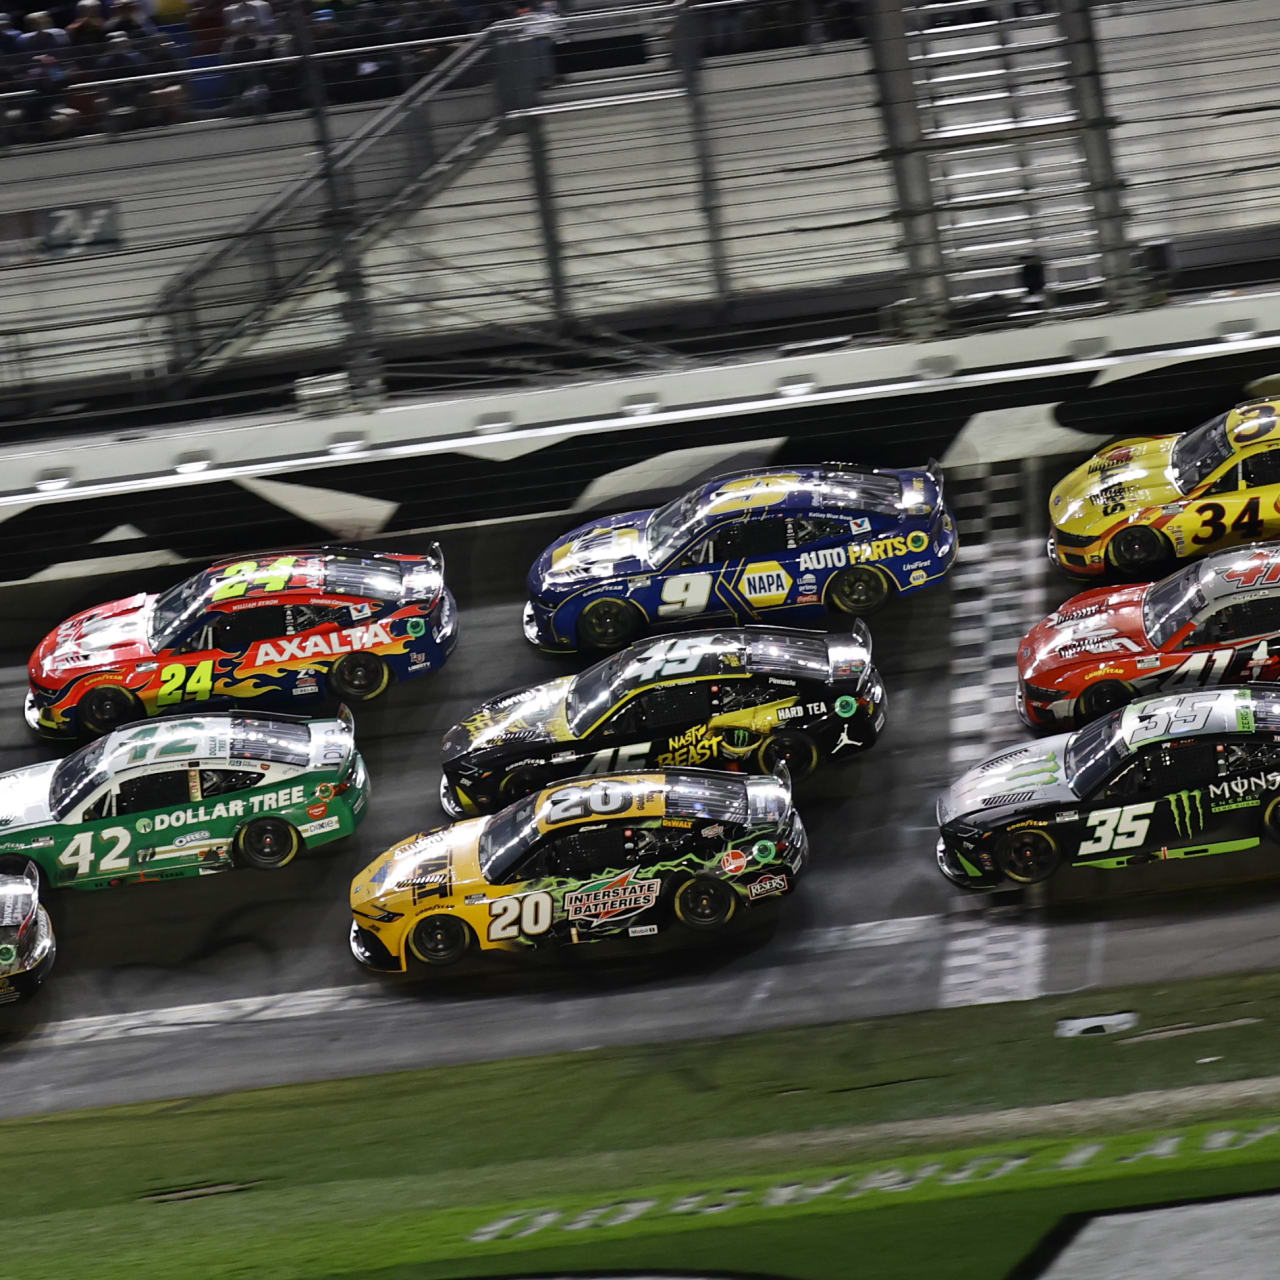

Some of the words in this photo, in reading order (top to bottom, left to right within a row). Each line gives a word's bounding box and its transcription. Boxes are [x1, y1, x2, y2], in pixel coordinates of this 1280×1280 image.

[1191, 496, 1265, 546] 34
[799, 546, 846, 571] AUTO
[847, 537, 907, 565] PARTS
[903, 560, 932, 571] UniFirst
[212, 556, 299, 602] 24
[657, 573, 713, 618] 9
[746, 574, 786, 595] NAPA
[254, 620, 393, 666] AXALTA
[157, 660, 214, 706] 24
[1085, 668, 1125, 680] GOODYEAR
[777, 707, 804, 721] HARD
[806, 702, 827, 715] TEA
[655, 735, 723, 768] BEAST
[668, 724, 708, 750] NASTY
[153, 800, 244, 831] DOLLAR
[249, 786, 306, 814] TREE
[1211, 793, 1260, 807] ENERGY
[174, 831, 210, 847] OREO
[1006, 819, 1048, 831] GOODYEAR
[1077, 802, 1157, 856] 35
[58, 826, 133, 876] 42
[569, 882, 656, 906] INTERSTATE
[573, 894, 652, 916] BATTERIES
[488, 890, 555, 943] 20
